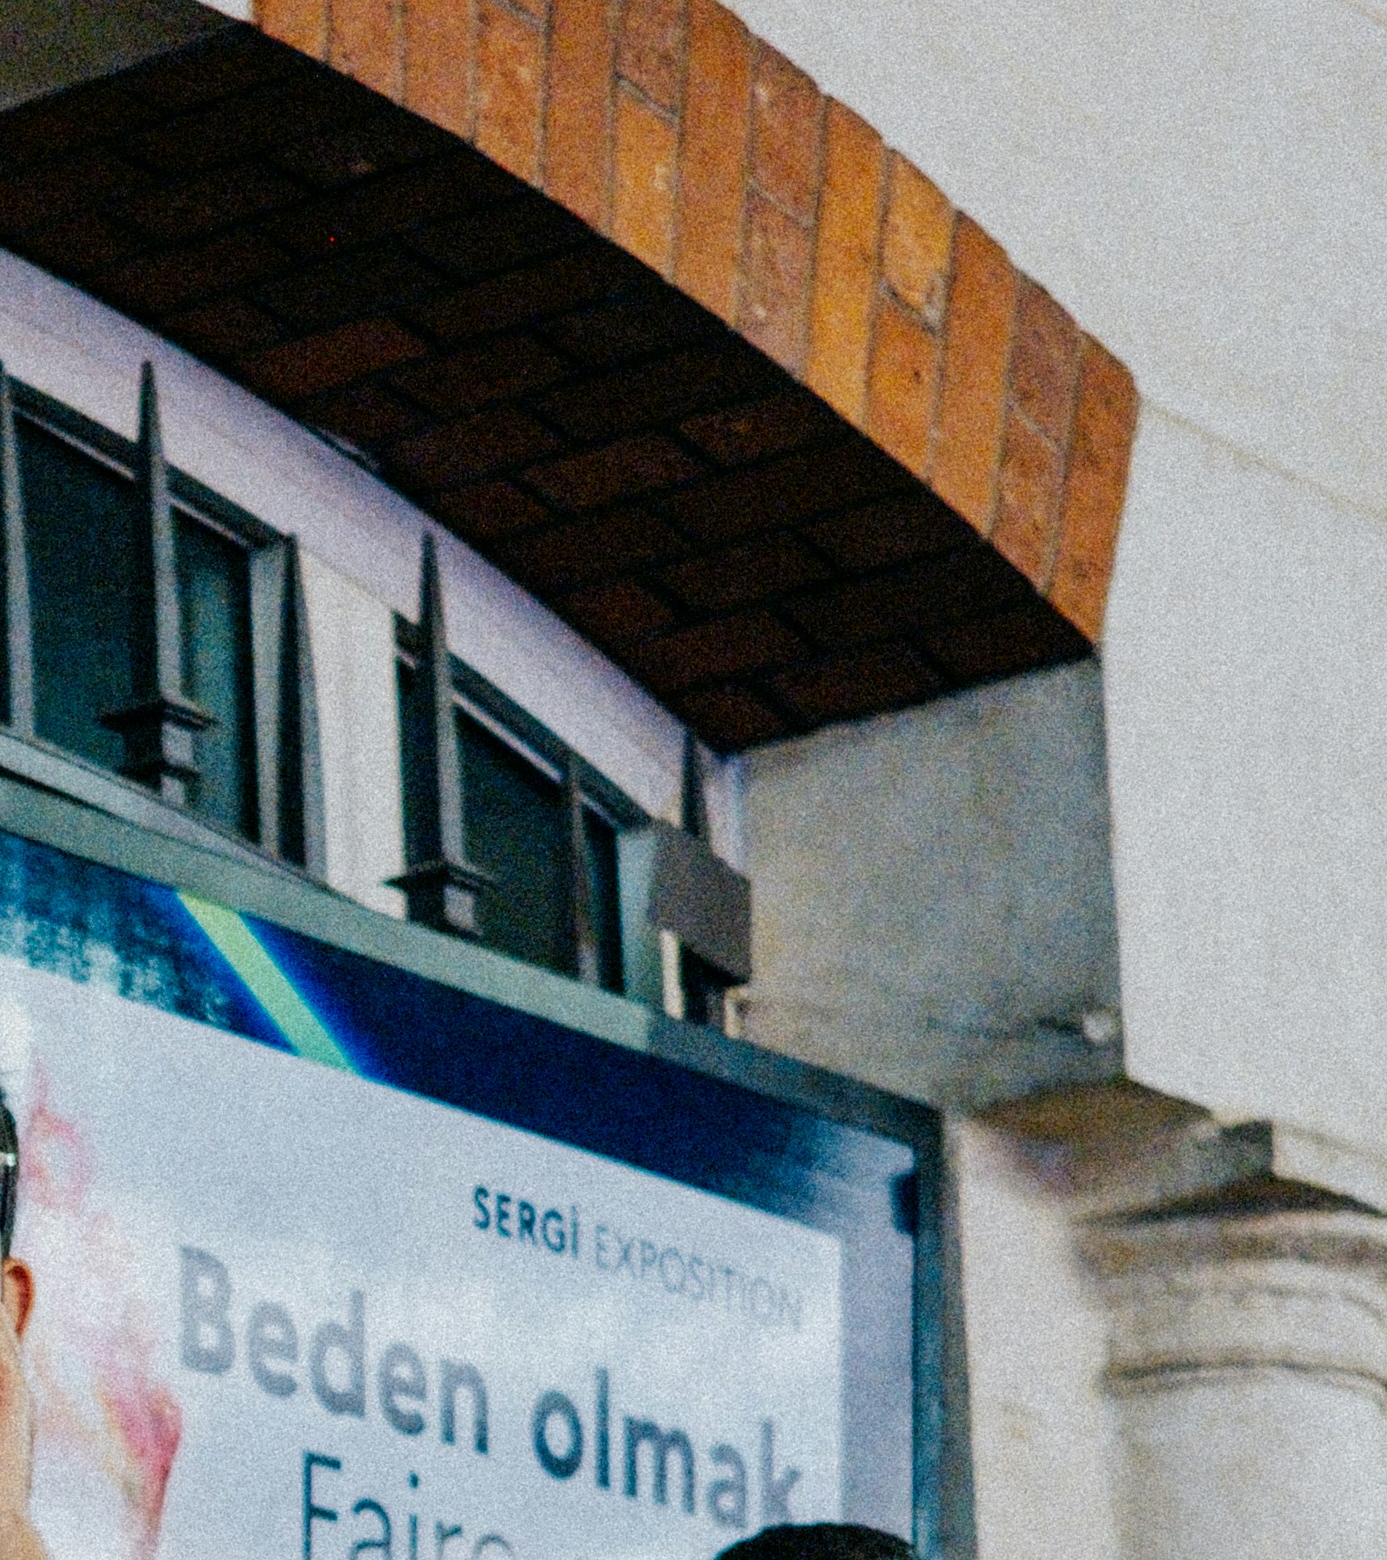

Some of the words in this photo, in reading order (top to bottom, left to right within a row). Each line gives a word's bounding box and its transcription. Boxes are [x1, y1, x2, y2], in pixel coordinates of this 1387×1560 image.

[473, 1185, 579, 1261] SERGİ
[594, 1222, 804, 1333] EXPOSITION
[179, 1244, 491, 1455] Beden
[532, 1366, 801, 1530] olmak
